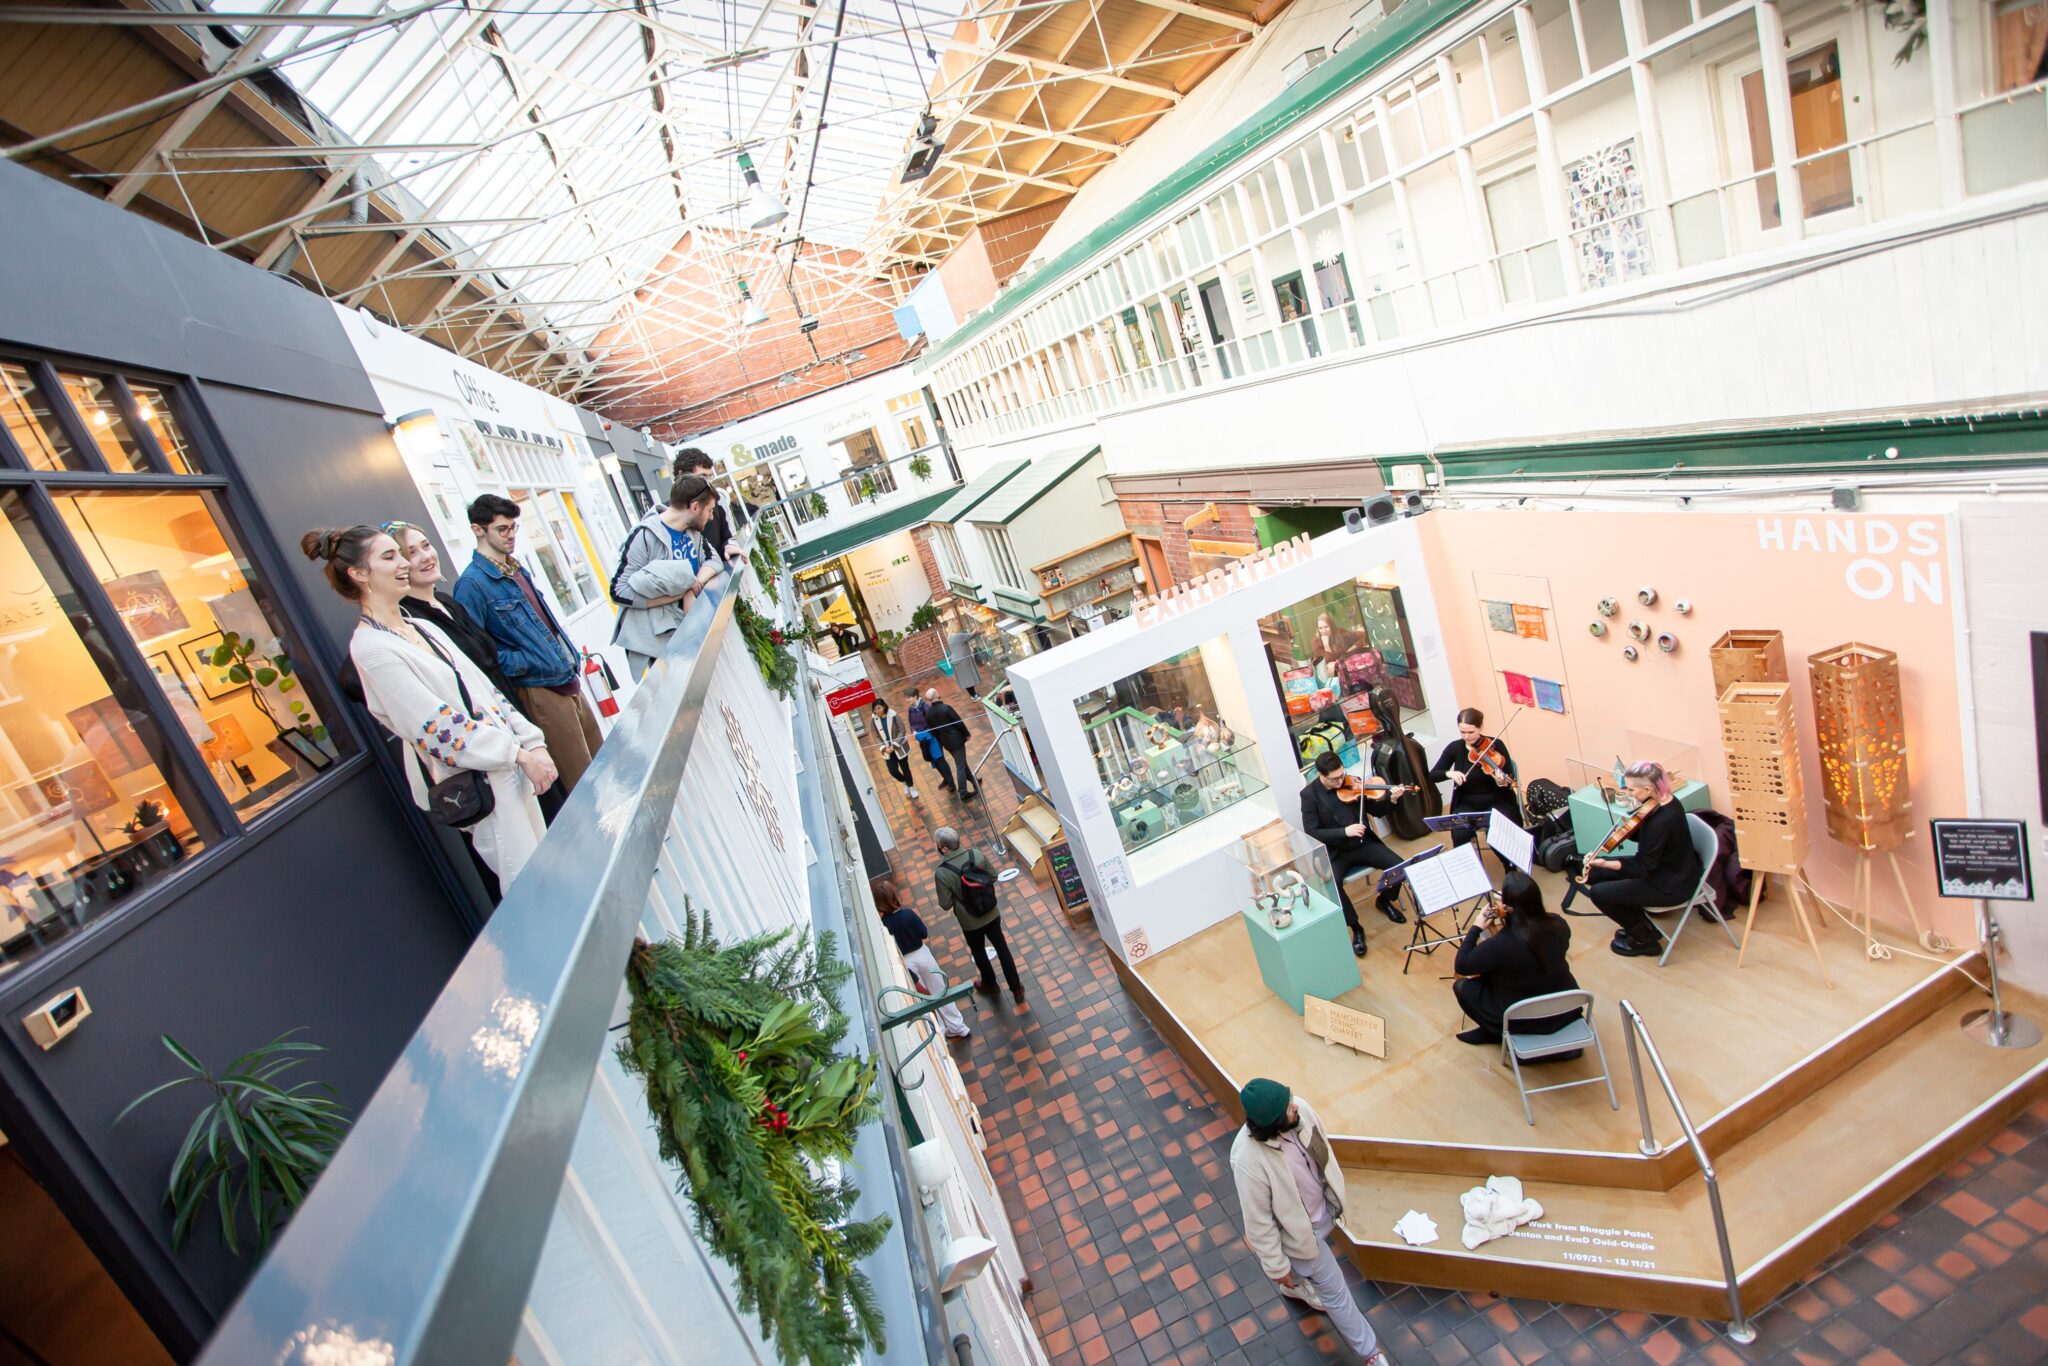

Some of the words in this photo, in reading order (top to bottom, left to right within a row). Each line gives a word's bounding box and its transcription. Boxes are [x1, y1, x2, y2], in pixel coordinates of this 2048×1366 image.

[453, 369, 500, 413] Office
[730, 443, 756, 467] &
[754, 435, 797, 460] made
[1757, 518, 1940, 557] HANDS
[1131, 531, 1314, 630] EXHIBITION
[1845, 558, 1944, 605] ON
[1528, 1220, 1553, 1229] Work
[1554, 1223, 1577, 1231] from
[1579, 1225, 1621, 1236] Bhaggie
[1563, 1252, 1602, 1263] 11/09/21
